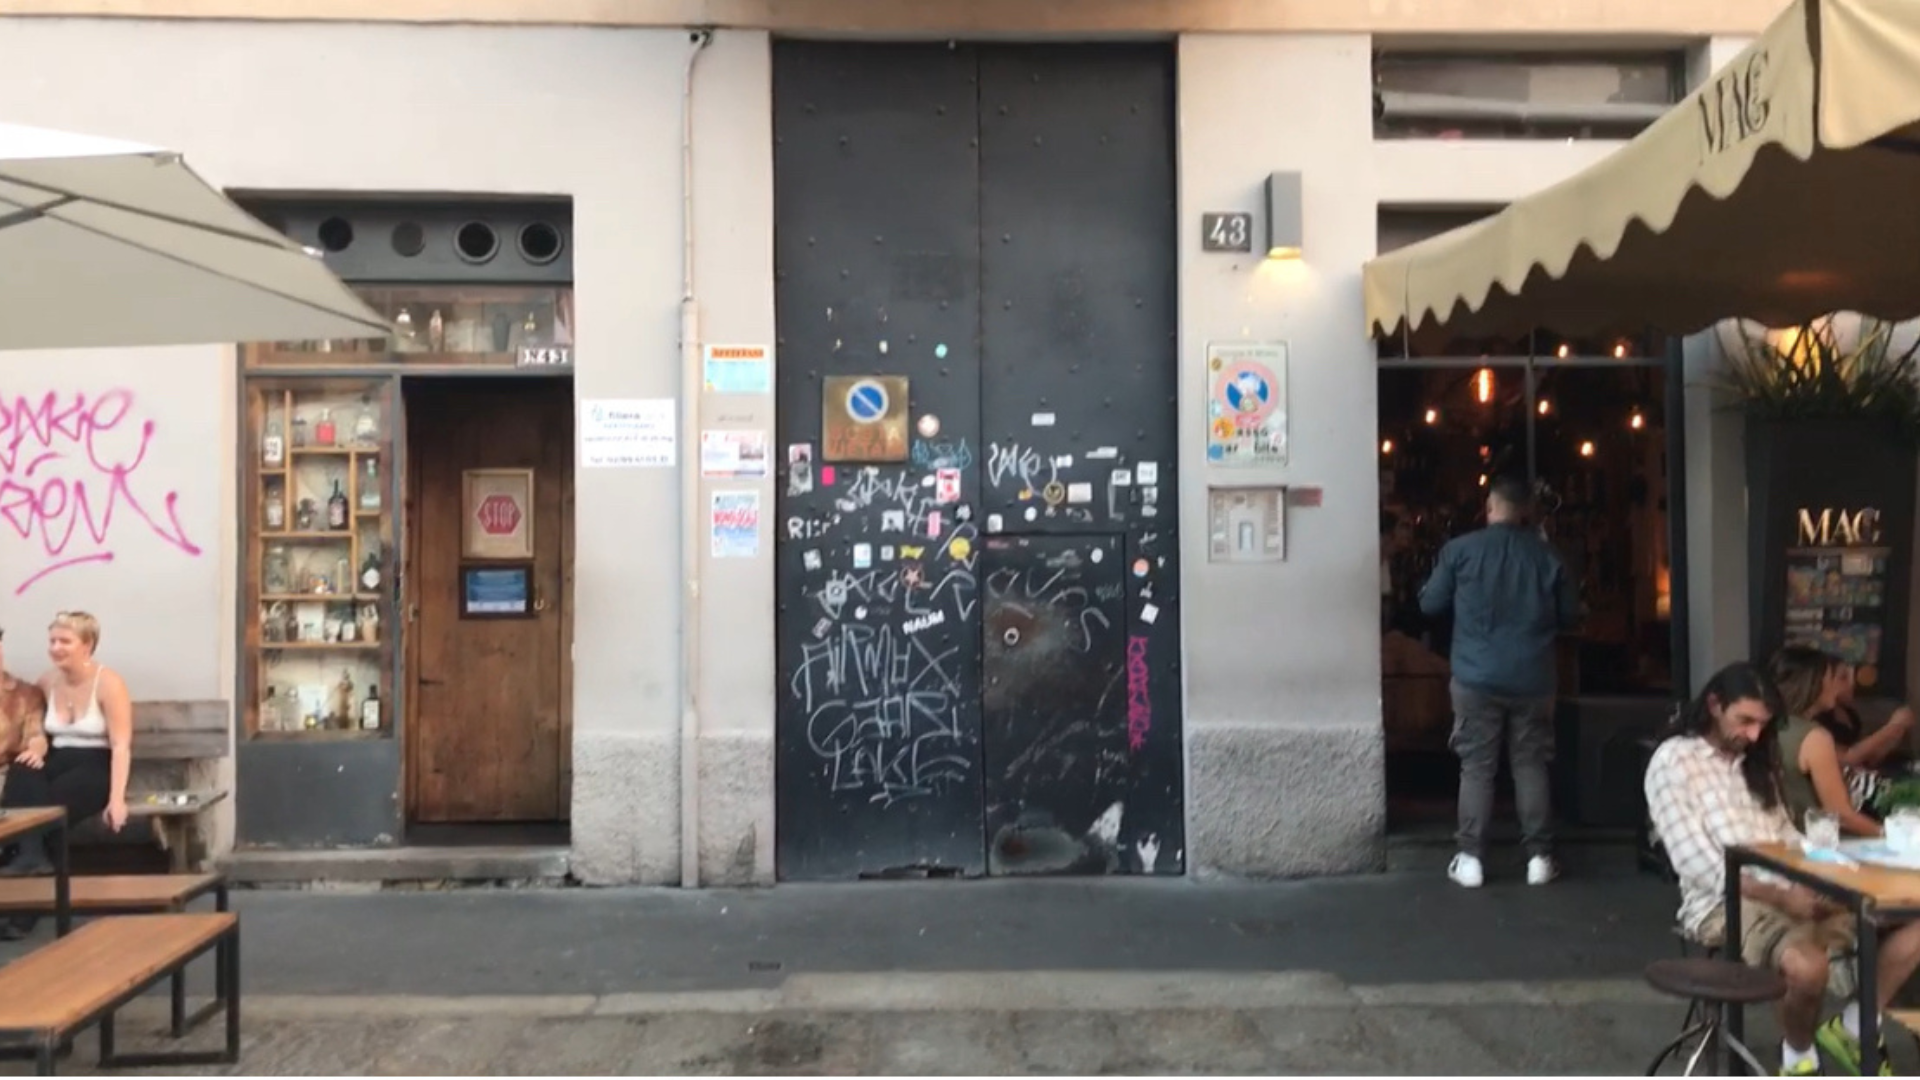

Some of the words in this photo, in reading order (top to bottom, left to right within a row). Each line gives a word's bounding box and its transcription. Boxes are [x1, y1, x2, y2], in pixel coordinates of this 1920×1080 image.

[1698, 50, 1770, 154] MAG
[1210, 216, 1246, 246] 43
[483, 501, 516, 529] STOP
